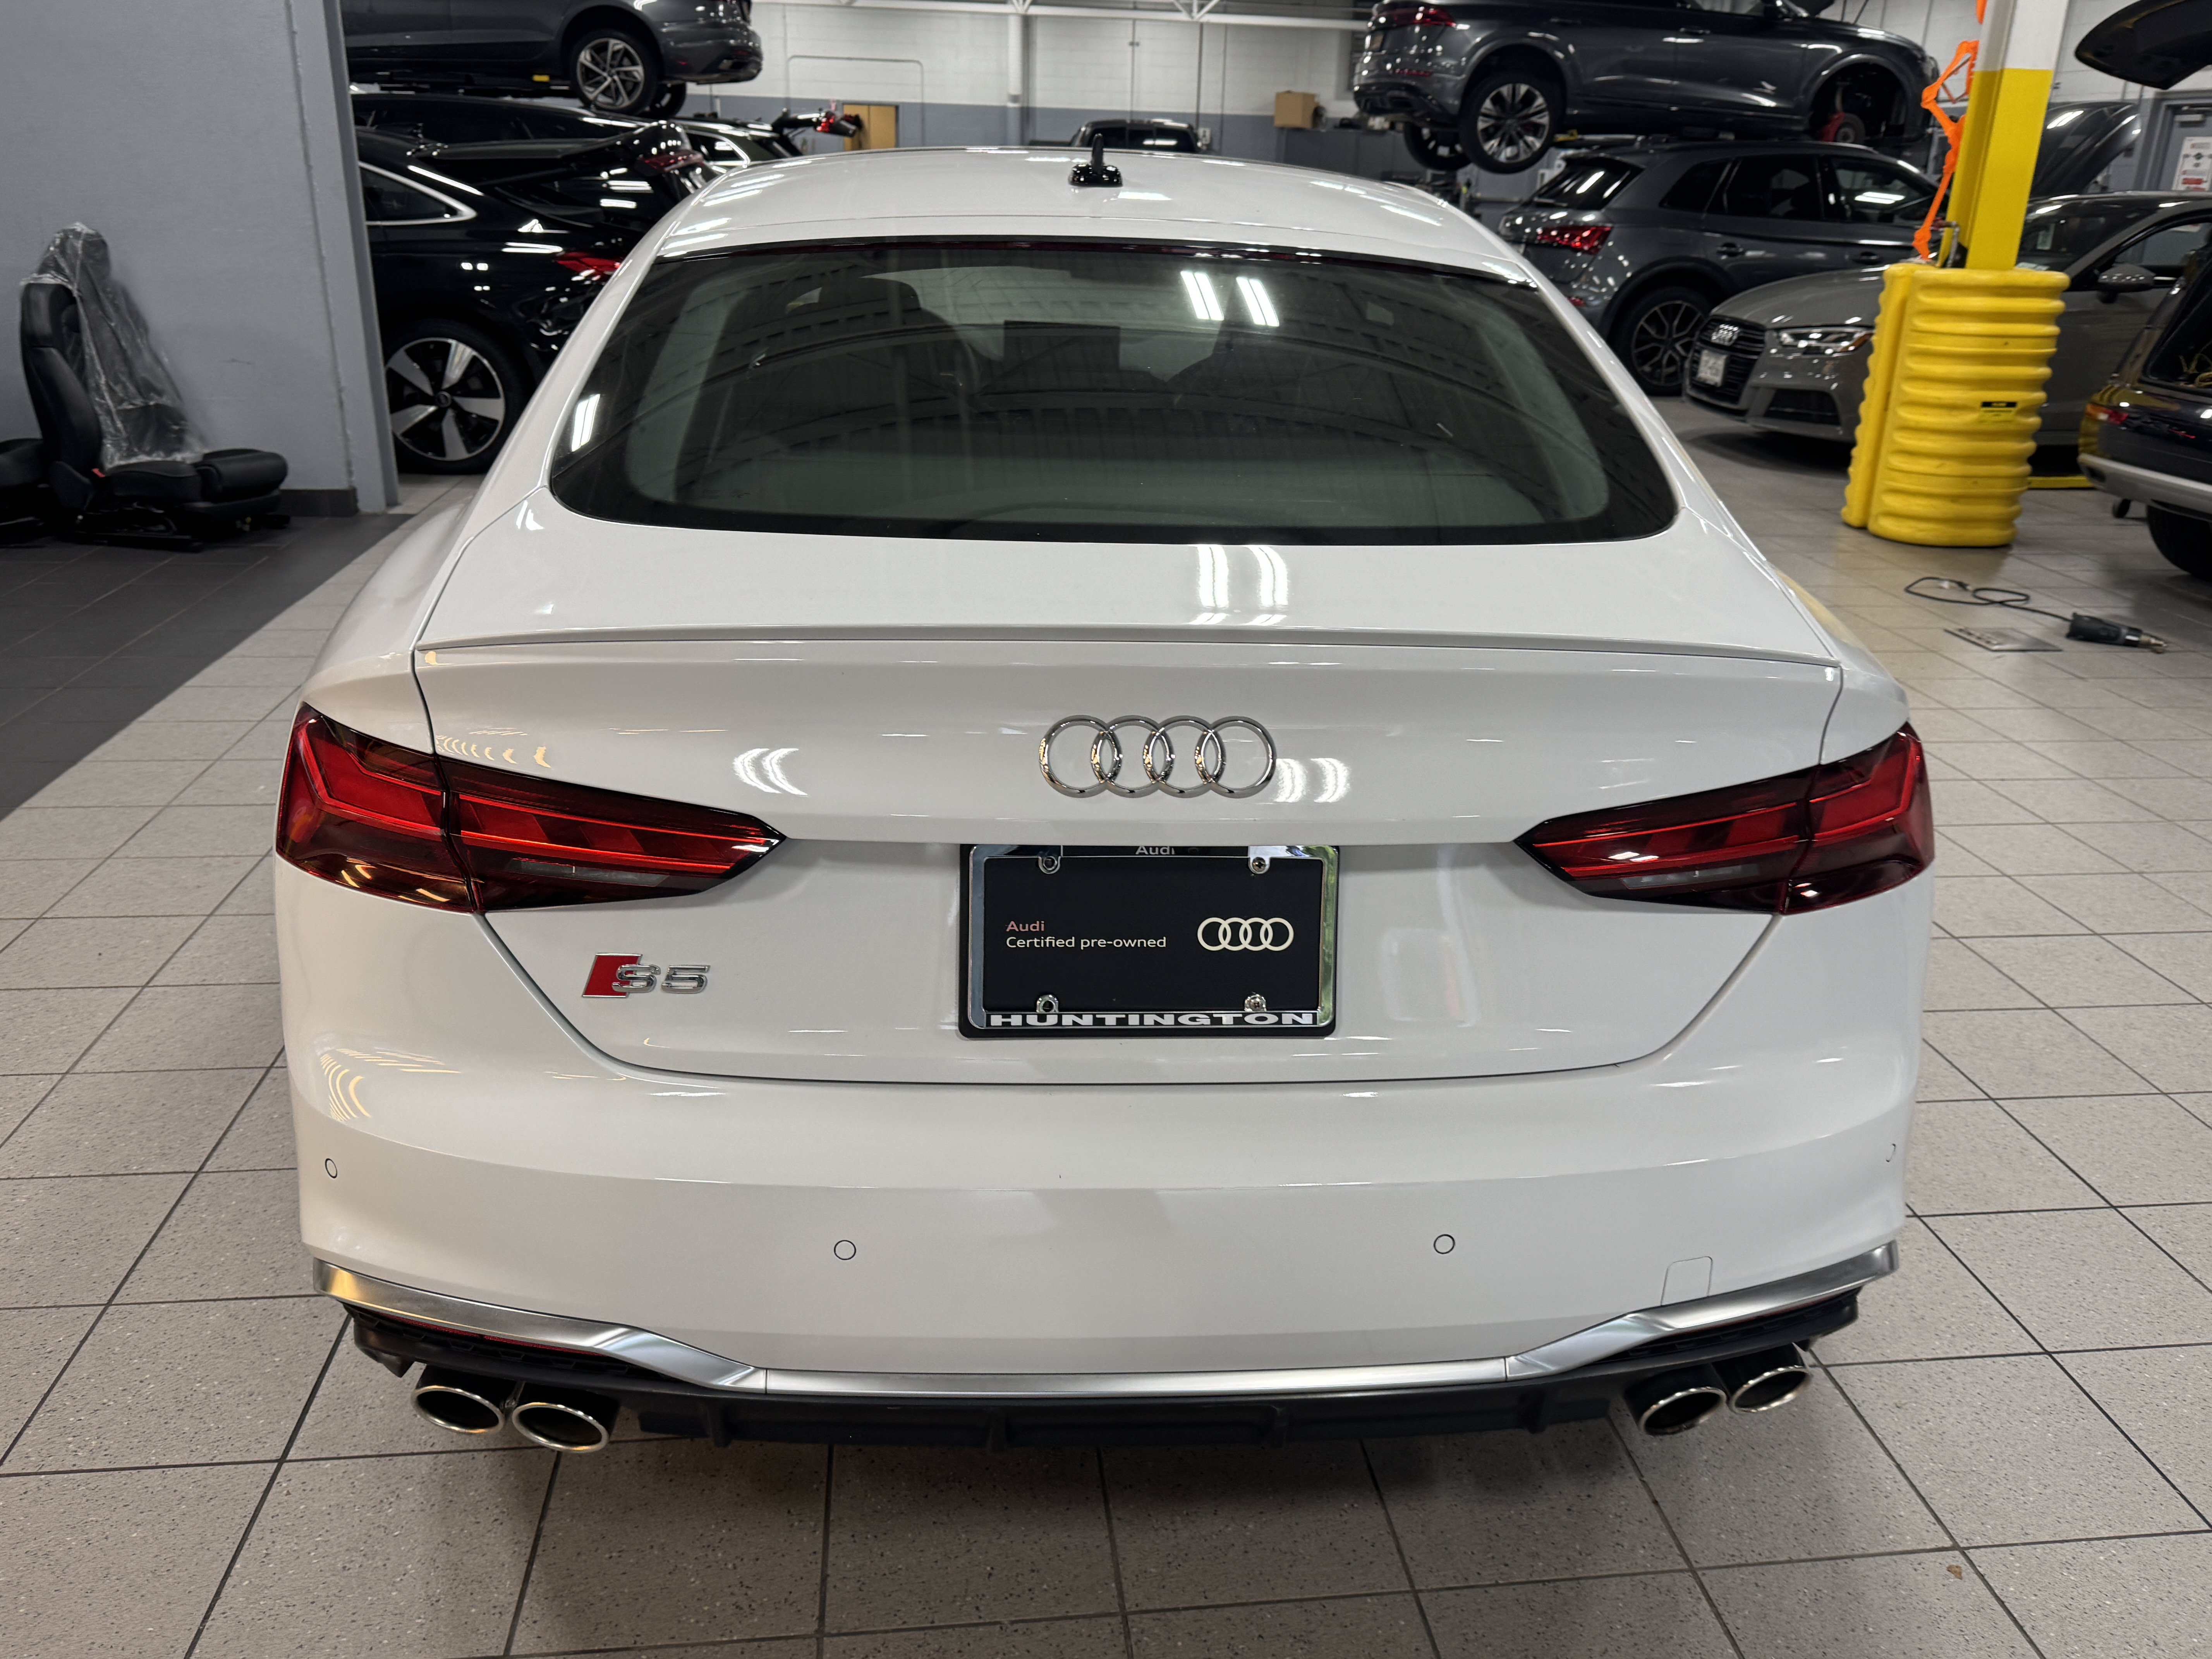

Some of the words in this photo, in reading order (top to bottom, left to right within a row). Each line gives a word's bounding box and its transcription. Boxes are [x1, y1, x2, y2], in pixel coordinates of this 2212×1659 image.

[1135, 846, 1175, 855] Audi
[1006, 921, 1045, 932] Audi
[1006, 936, 1075, 948] Certified
[1080, 936, 1166, 950] pre-owned
[611, 963, 711, 994] S5
[990, 1013, 1313, 1026] HUNTINGTON
